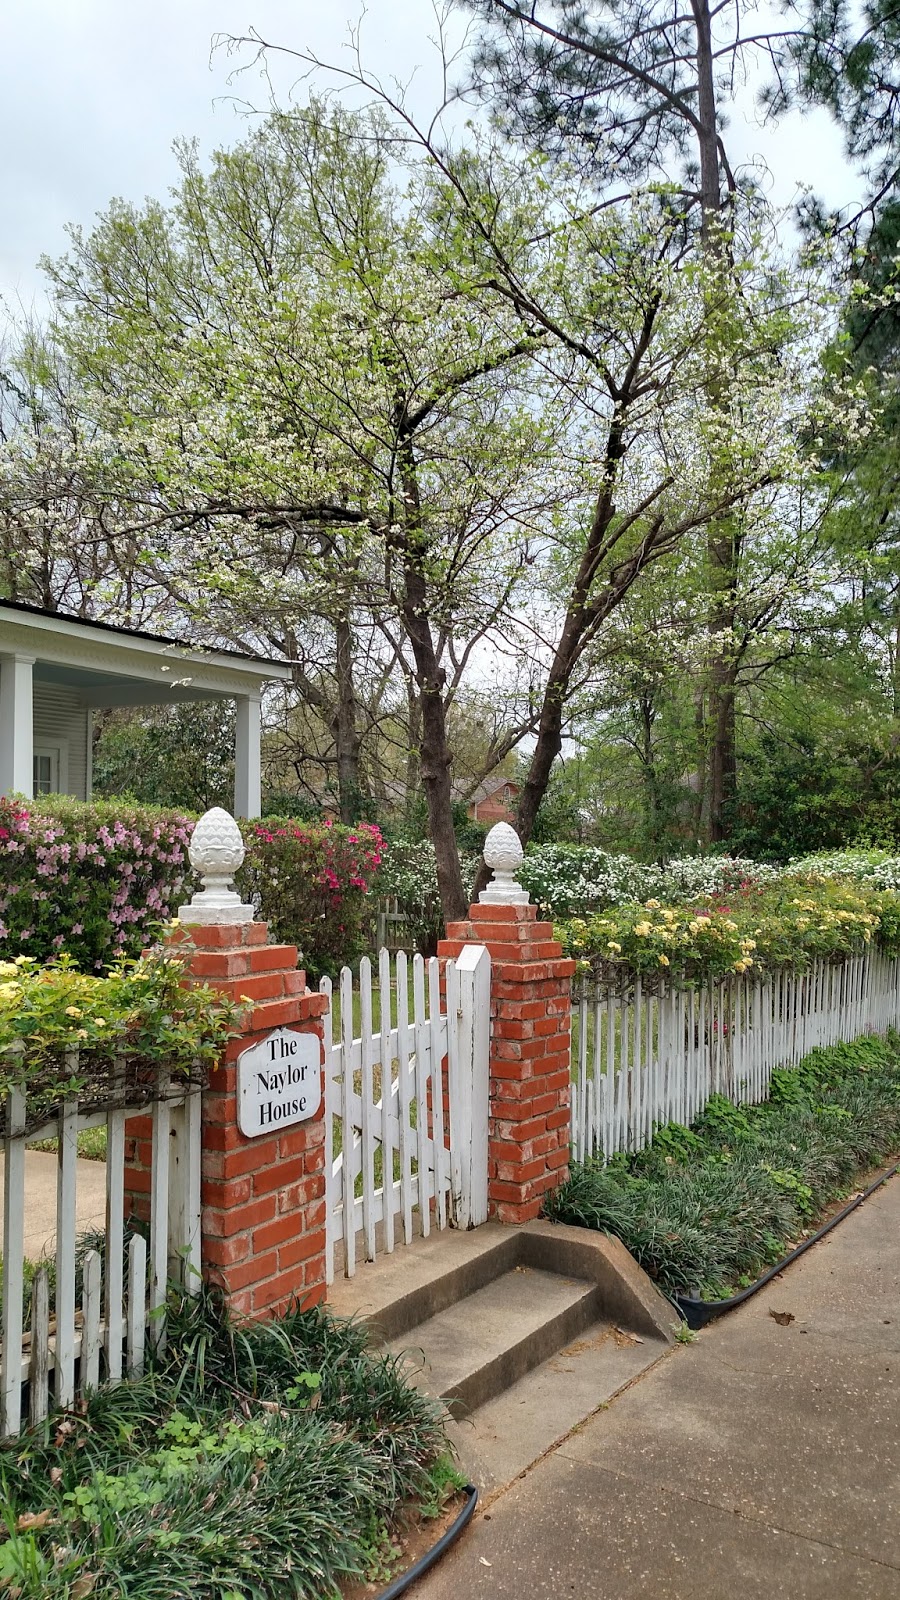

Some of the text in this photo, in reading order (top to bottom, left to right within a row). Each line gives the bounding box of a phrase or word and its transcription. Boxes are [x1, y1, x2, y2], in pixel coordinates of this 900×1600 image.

[267, 1038, 297, 1061] The
[256, 1064, 308, 1094] Naylor
[259, 1096, 307, 1126] House
